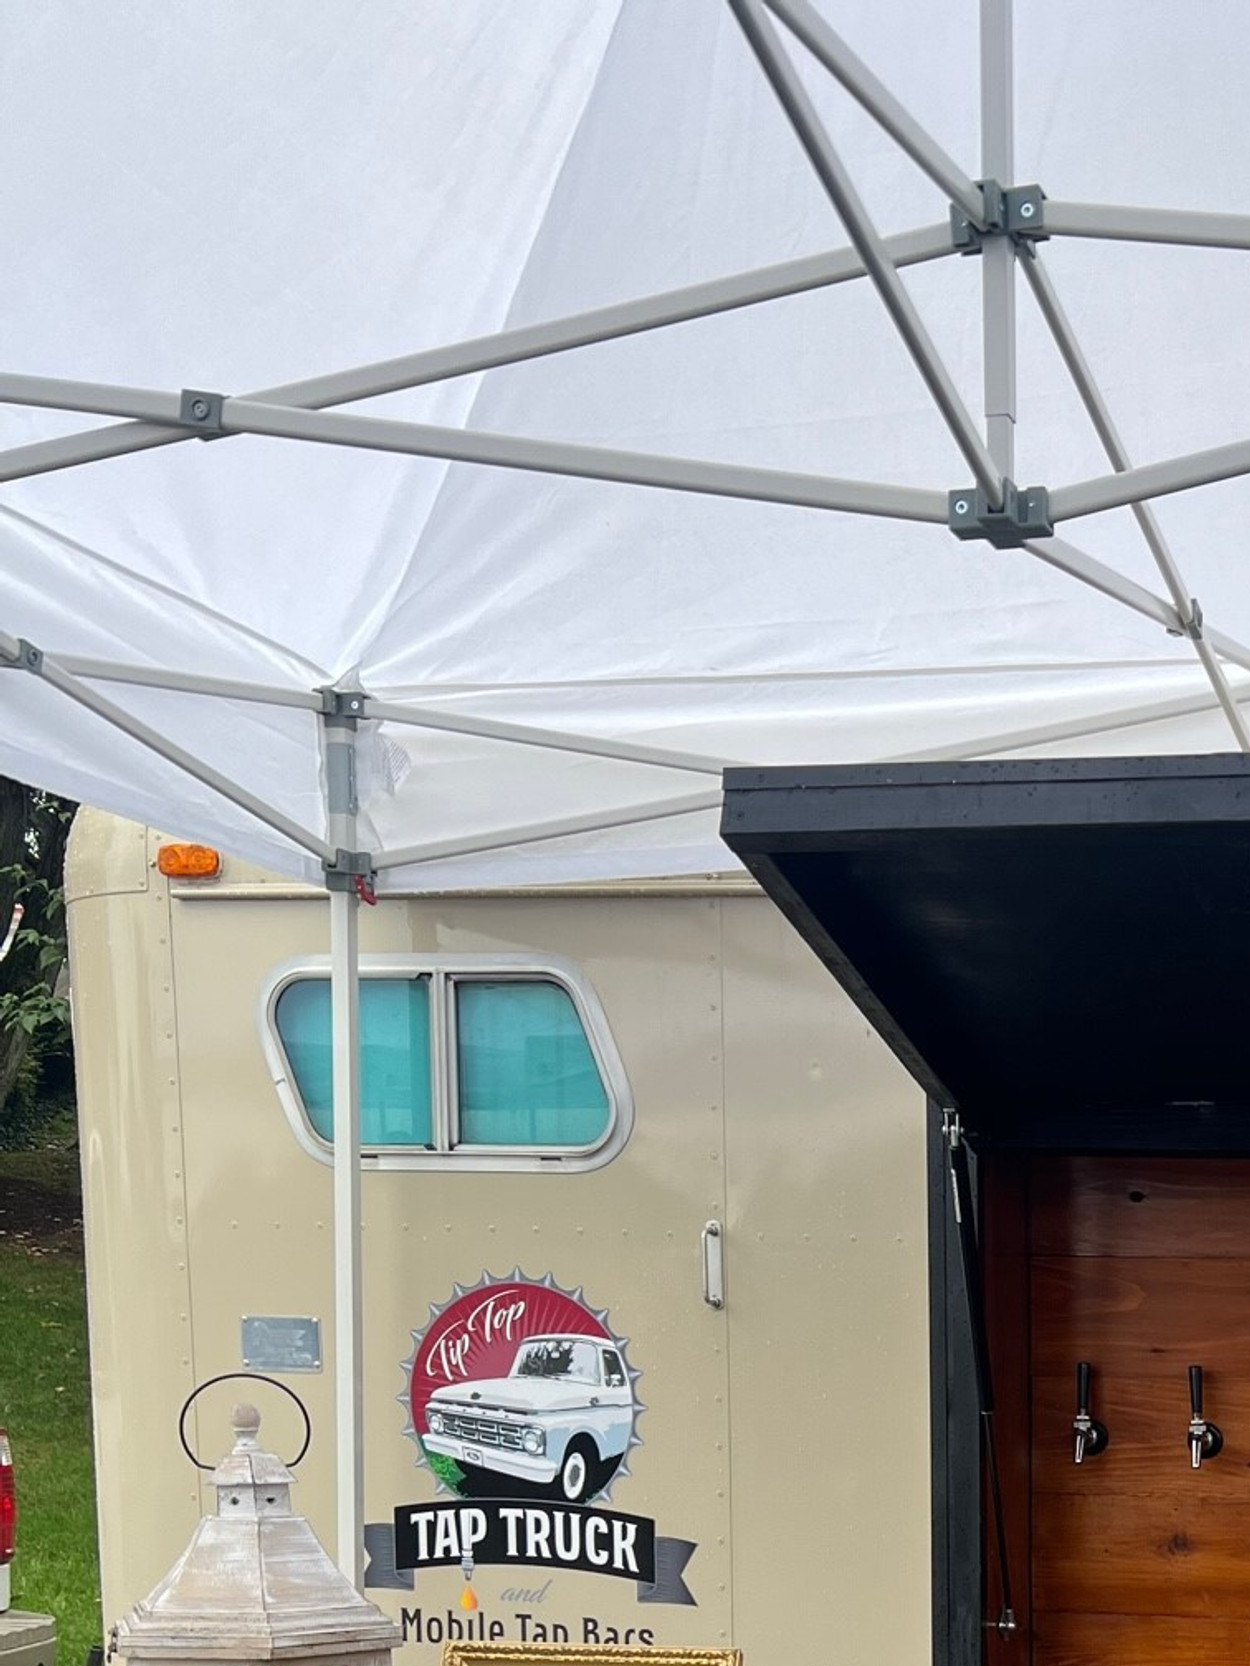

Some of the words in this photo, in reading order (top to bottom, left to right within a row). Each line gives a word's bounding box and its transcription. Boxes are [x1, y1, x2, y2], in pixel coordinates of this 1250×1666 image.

[426, 1320, 469, 1381] Tip
[467, 1289, 525, 1343] Top
[410, 1508, 487, 1560] TAP
[499, 1508, 640, 1573] TRUCK
[500, 1579, 553, 1604] and
[401, 1608, 505, 1644] Mobile
[515, 1614, 569, 1644] Tap
[583, 1617, 655, 1647] Bars
